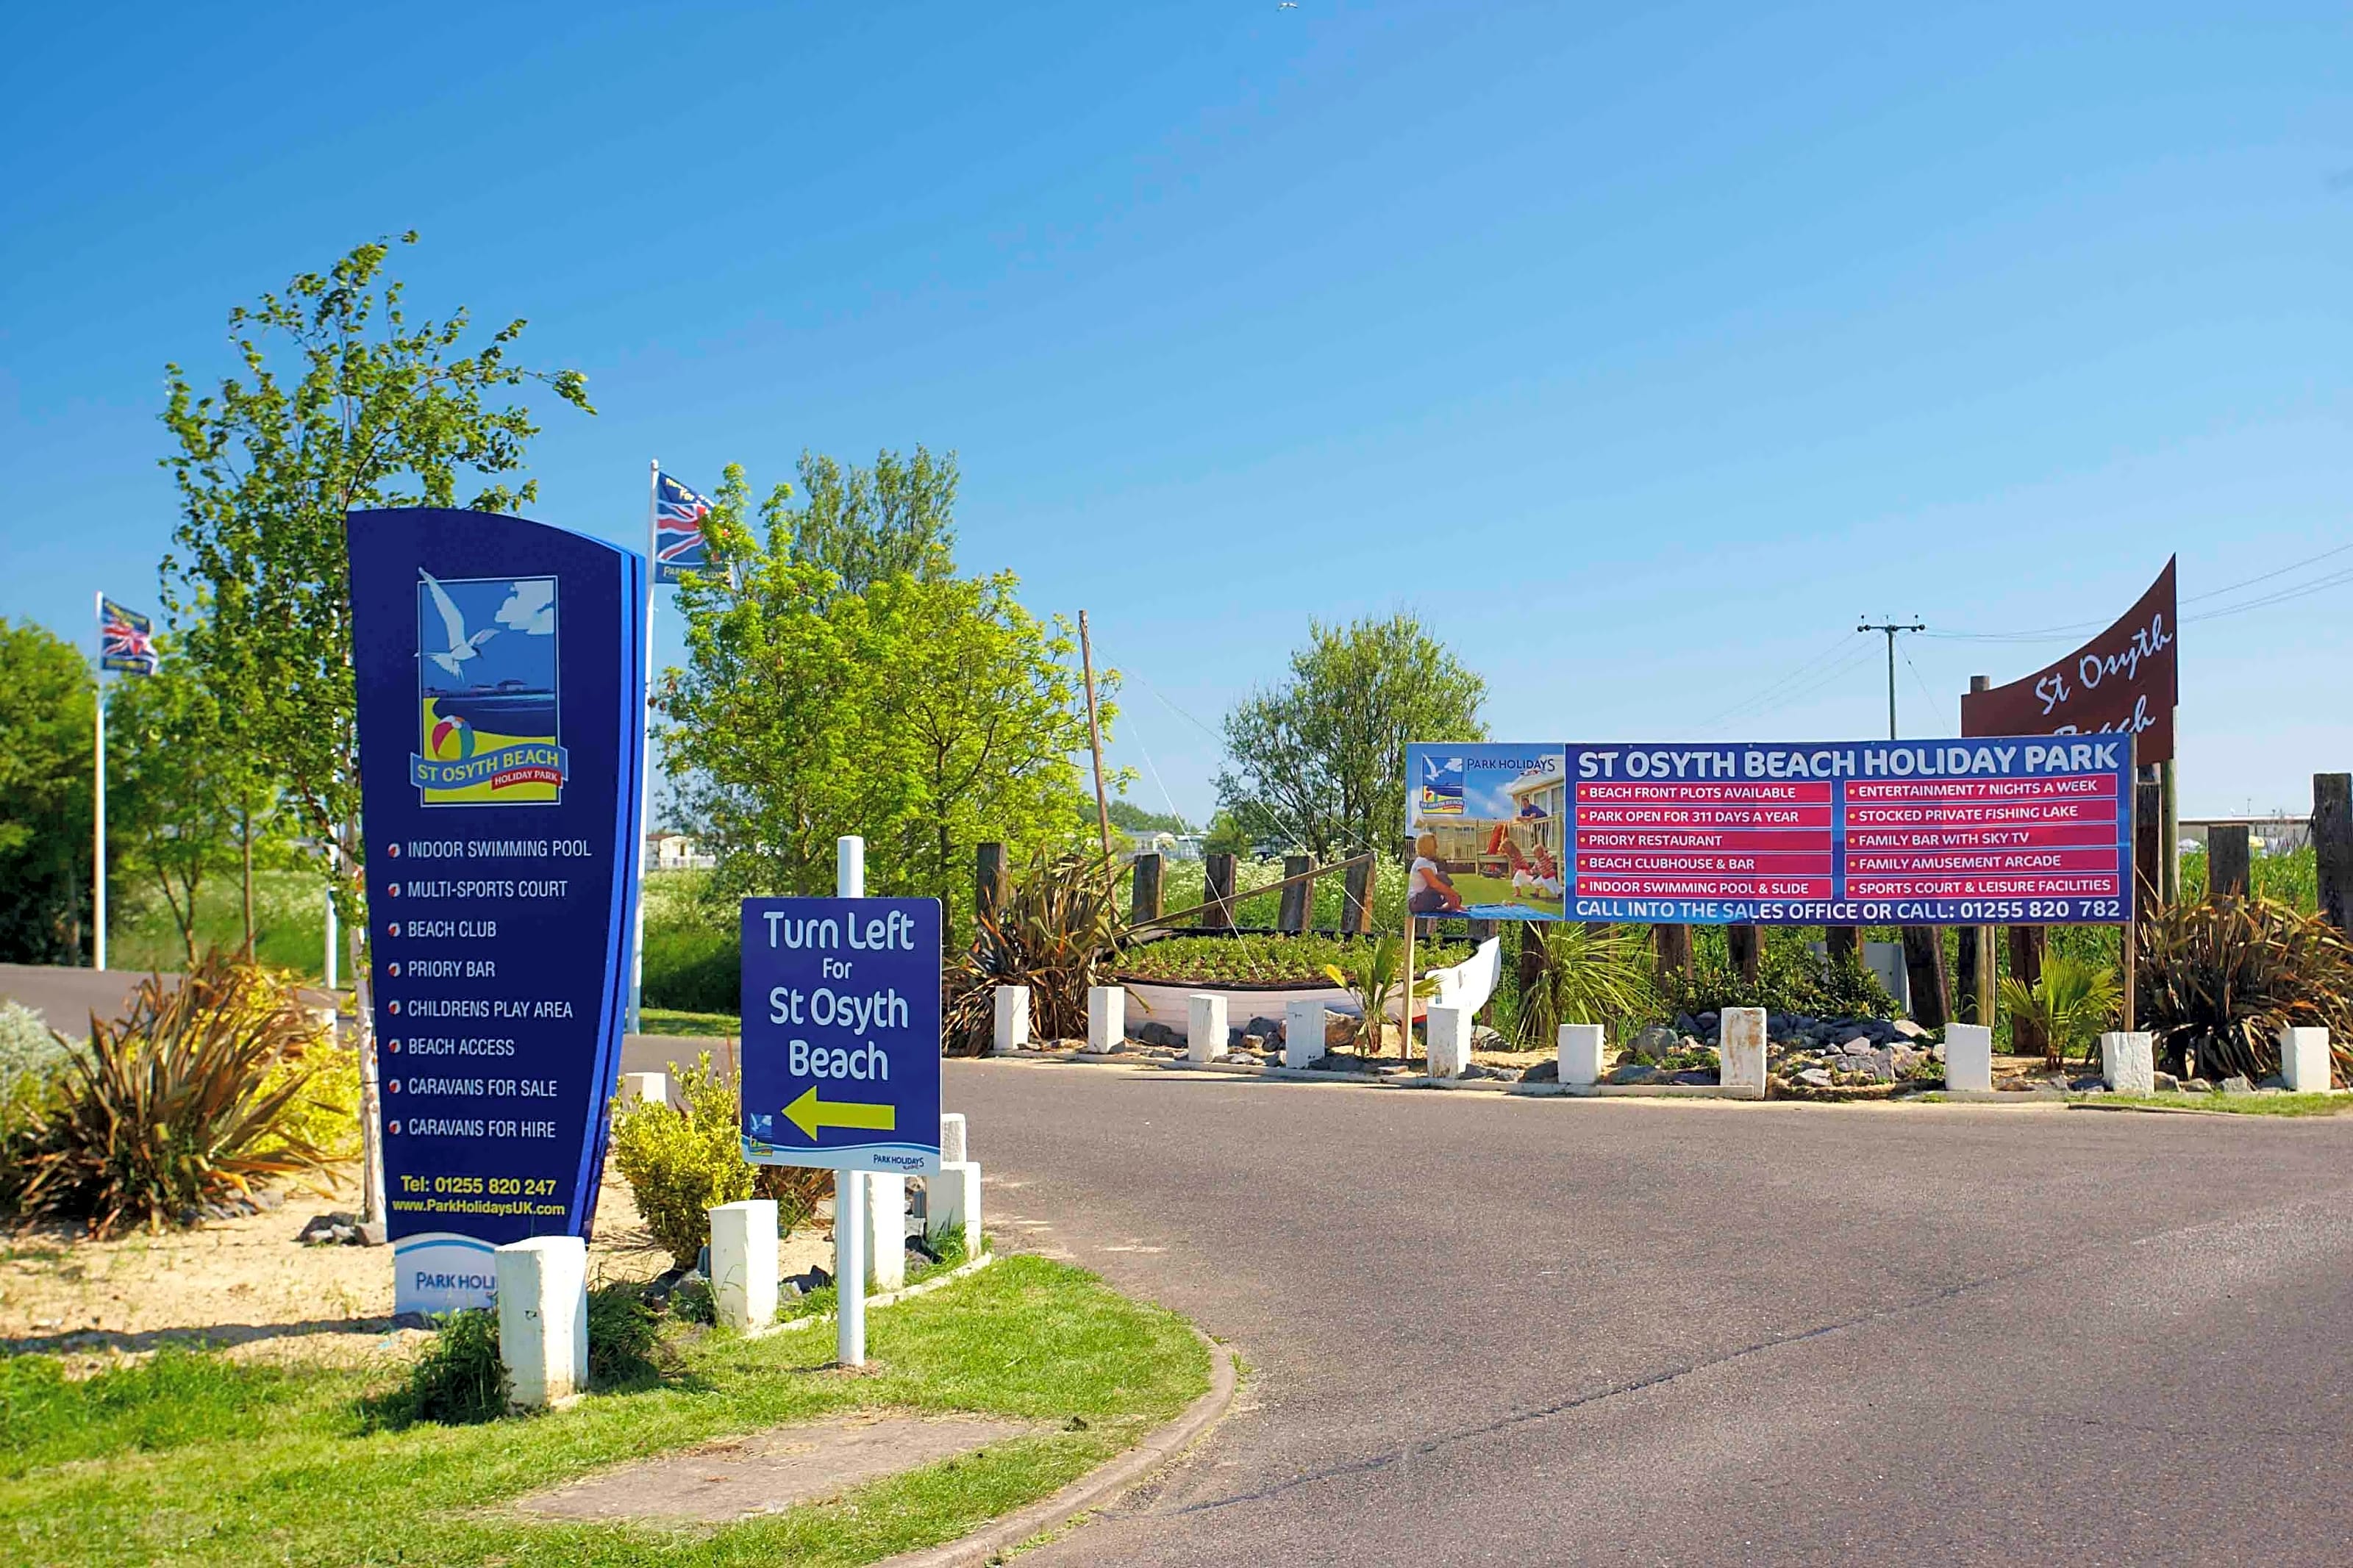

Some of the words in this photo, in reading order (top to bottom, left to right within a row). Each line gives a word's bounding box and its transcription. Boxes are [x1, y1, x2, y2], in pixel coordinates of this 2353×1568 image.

[2035, 673, 2071, 715] St
[2079, 614, 2173, 690] Osyth
[418, 764, 438, 781] ST
[443, 756, 498, 783] OSYTH
[503, 749, 559, 768] BEACH
[1467, 759, 1496, 770] PARK
[1499, 759, 1555, 772] HOLIDAYS
[1579, 751, 1618, 778] ST
[1626, 751, 1736, 778] OSYTH
[1744, 751, 1855, 778] BEACH
[1864, 746, 2017, 777] HOLIDAY
[2024, 742, 2120, 772] PARK
[494, 770, 533, 786] HOLIDAY
[534, 770, 558, 781] PARK
[1589, 787, 1631, 798] BEACH
[1635, 787, 1677, 798] FRONT
[1680, 787, 1721, 798] PLOTS
[1724, 787, 1796, 798] AVAILABLE
[1859, 784, 1974, 797] ENTERTAINMENT
[1977, 784, 1985, 795] 7
[1989, 781, 2040, 795] NIGHTS
[2043, 781, 2054, 792] A
[2056, 780, 2097, 792] WEEK
[1589, 811, 1622, 822] PARK
[1626, 811, 1660, 823] OPEN
[1664, 812, 1689, 823] FOR
[1692, 811, 1712, 823] 311
[1715, 811, 1749, 823] DAYS
[1753, 811, 1763, 823] A
[1765, 811, 1799, 823] YEAR
[1859, 809, 1921, 822] STOCKED
[1925, 809, 1982, 821] PRIVATE
[1985, 807, 2040, 820] FISHING
[2043, 806, 2078, 817] LAKE
[1589, 835, 1635, 846] PRIORY
[1638, 835, 1723, 846] RESTAURANT
[1859, 835, 1908, 846] FAMILY
[1912, 834, 1940, 846] BAR
[1942, 834, 1979, 845] WITH
[1982, 833, 2009, 844] SKY
[2011, 832, 2029, 843] TV
[407, 842, 463, 859] INDOOR
[468, 840, 548, 858] SWIMMING
[552, 840, 592, 857] POOL
[1589, 858, 1631, 869] BEACH
[1635, 858, 1713, 870] CLUBHOUSE
[1716, 859, 1726, 870] &
[1729, 859, 1754, 870] BAR
[1859, 858, 1909, 870] FAMILY
[1912, 856, 2002, 869] AMUSEMENT
[2004, 855, 2061, 867] ARCADE
[407, 881, 514, 898] MULTI-SPORTS
[518, 881, 568, 898] COURT
[1589, 881, 1640, 893] INDOOR
[1643, 881, 1717, 893] SWIMMING
[1720, 883, 1756, 894] POOL
[1758, 883, 1768, 894] &
[1771, 883, 1809, 894] SLIDE
[1859, 882, 1912, 894] SPORTS
[1915, 881, 1961, 893] COURT
[1965, 881, 1976, 893] &
[1979, 881, 2035, 893] LEISURE
[2038, 879, 2110, 892] FACILITIES
[1576, 901, 1623, 917] CALL
[1628, 901, 1674, 917] INTO
[1679, 902, 1718, 918] THE
[1722, 903, 1784, 919] SALES
[1789, 903, 1857, 920] OFFICE
[1863, 903, 1892, 920] OR
[1896, 903, 1954, 919] CALL:
[1960, 901, 2023, 918] 01255
[2029, 901, 2069, 917] 820
[2079, 900, 2120, 917] 782
[407, 921, 454, 937] BEACH
[458, 921, 497, 937] CLUB
[763, 911, 838, 949] Turn
[848, 910, 915, 951] Left
[408, 961, 462, 977] PRIORY
[465, 961, 496, 977] BAR
[823, 957, 852, 979] For
[407, 1000, 489, 1017] CHILDRENS
[493, 1001, 529, 1018] PLAY
[534, 1001, 573, 1018] AREA
[769, 987, 804, 1025] St
[810, 987, 909, 1036] Osyth
[408, 1039, 454, 1055] BEACH
[458, 1039, 515, 1056] ACCESS
[789, 1039, 888, 1081] Beach
[408, 1078, 484, 1096] CARAVANS
[488, 1079, 516, 1096] FOR
[520, 1080, 557, 1097] SALE
[408, 1119, 484, 1136] CARAVANS
[488, 1120, 516, 1137] FOR
[521, 1121, 557, 1138] HIRE
[874, 1154, 890, 1164] PARK
[891, 1156, 924, 1167] HOLIDAYS
[401, 1175, 430, 1192] Tel:
[435, 1176, 483, 1195] 01255
[488, 1178, 520, 1195] 820
[525, 1179, 557, 1196] 247
[392, 1198, 565, 1217] www.ParkHolidaysUK.com
[416, 1271, 456, 1291] PARK
[457, 1274, 496, 1289] HOLI
